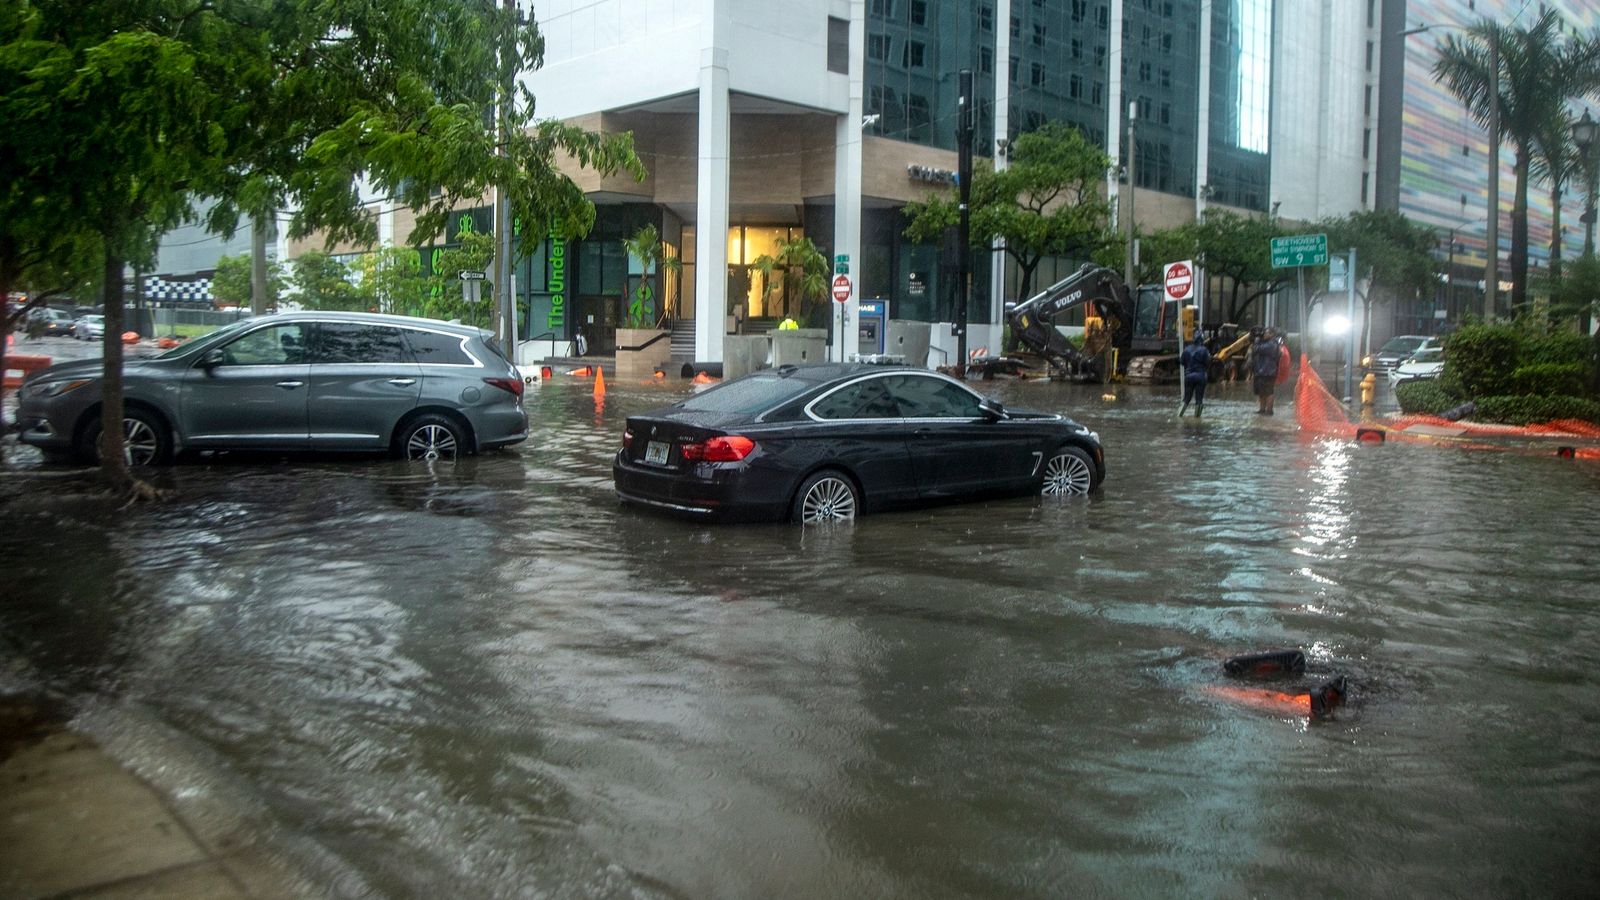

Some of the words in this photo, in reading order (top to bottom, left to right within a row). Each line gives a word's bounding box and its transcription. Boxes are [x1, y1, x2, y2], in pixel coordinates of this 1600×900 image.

[1275, 256, 1289, 264] SW
[1296, 253, 1303, 264] 9
[1314, 254, 1324, 263] ST
[1168, 270, 1175, 278] DO
[1177, 268, 1187, 276] NOT
[1170, 285, 1187, 294] ENTER
[1055, 289, 1082, 308] VOLVO
